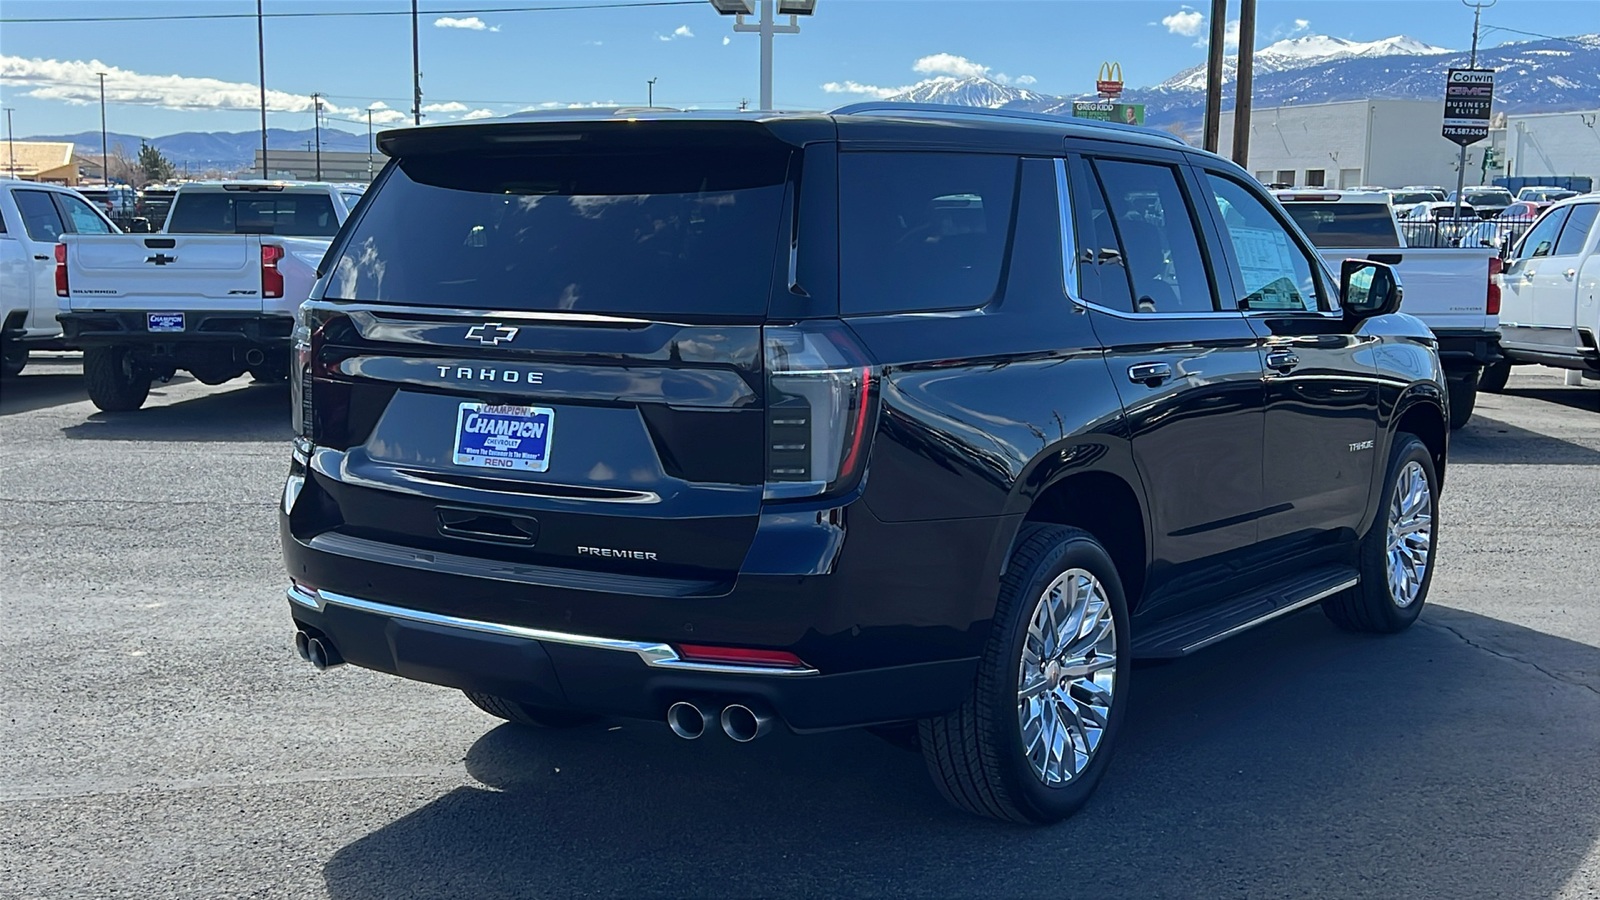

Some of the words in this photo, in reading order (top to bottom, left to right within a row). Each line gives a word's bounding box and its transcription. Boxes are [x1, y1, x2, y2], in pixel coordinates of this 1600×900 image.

[1453, 73, 1493, 82] Corwin
[1448, 86, 1491, 96] GMC
[1076, 103, 1097, 111] GREG
[1097, 103, 1114, 112] KIDD
[1447, 101, 1490, 109] BUSINESS
[150, 315, 183, 323] CHAMPION
[436, 365, 545, 385] TAHOE
[483, 406, 528, 416] CHAMPION
[464, 413, 545, 439] CHAMPION
[486, 438, 518, 447] CHEVROLET
[1348, 439, 1374, 452] TAHOE
[484, 458, 513, 468] RENO
[577, 546, 658, 561] PREMIER
